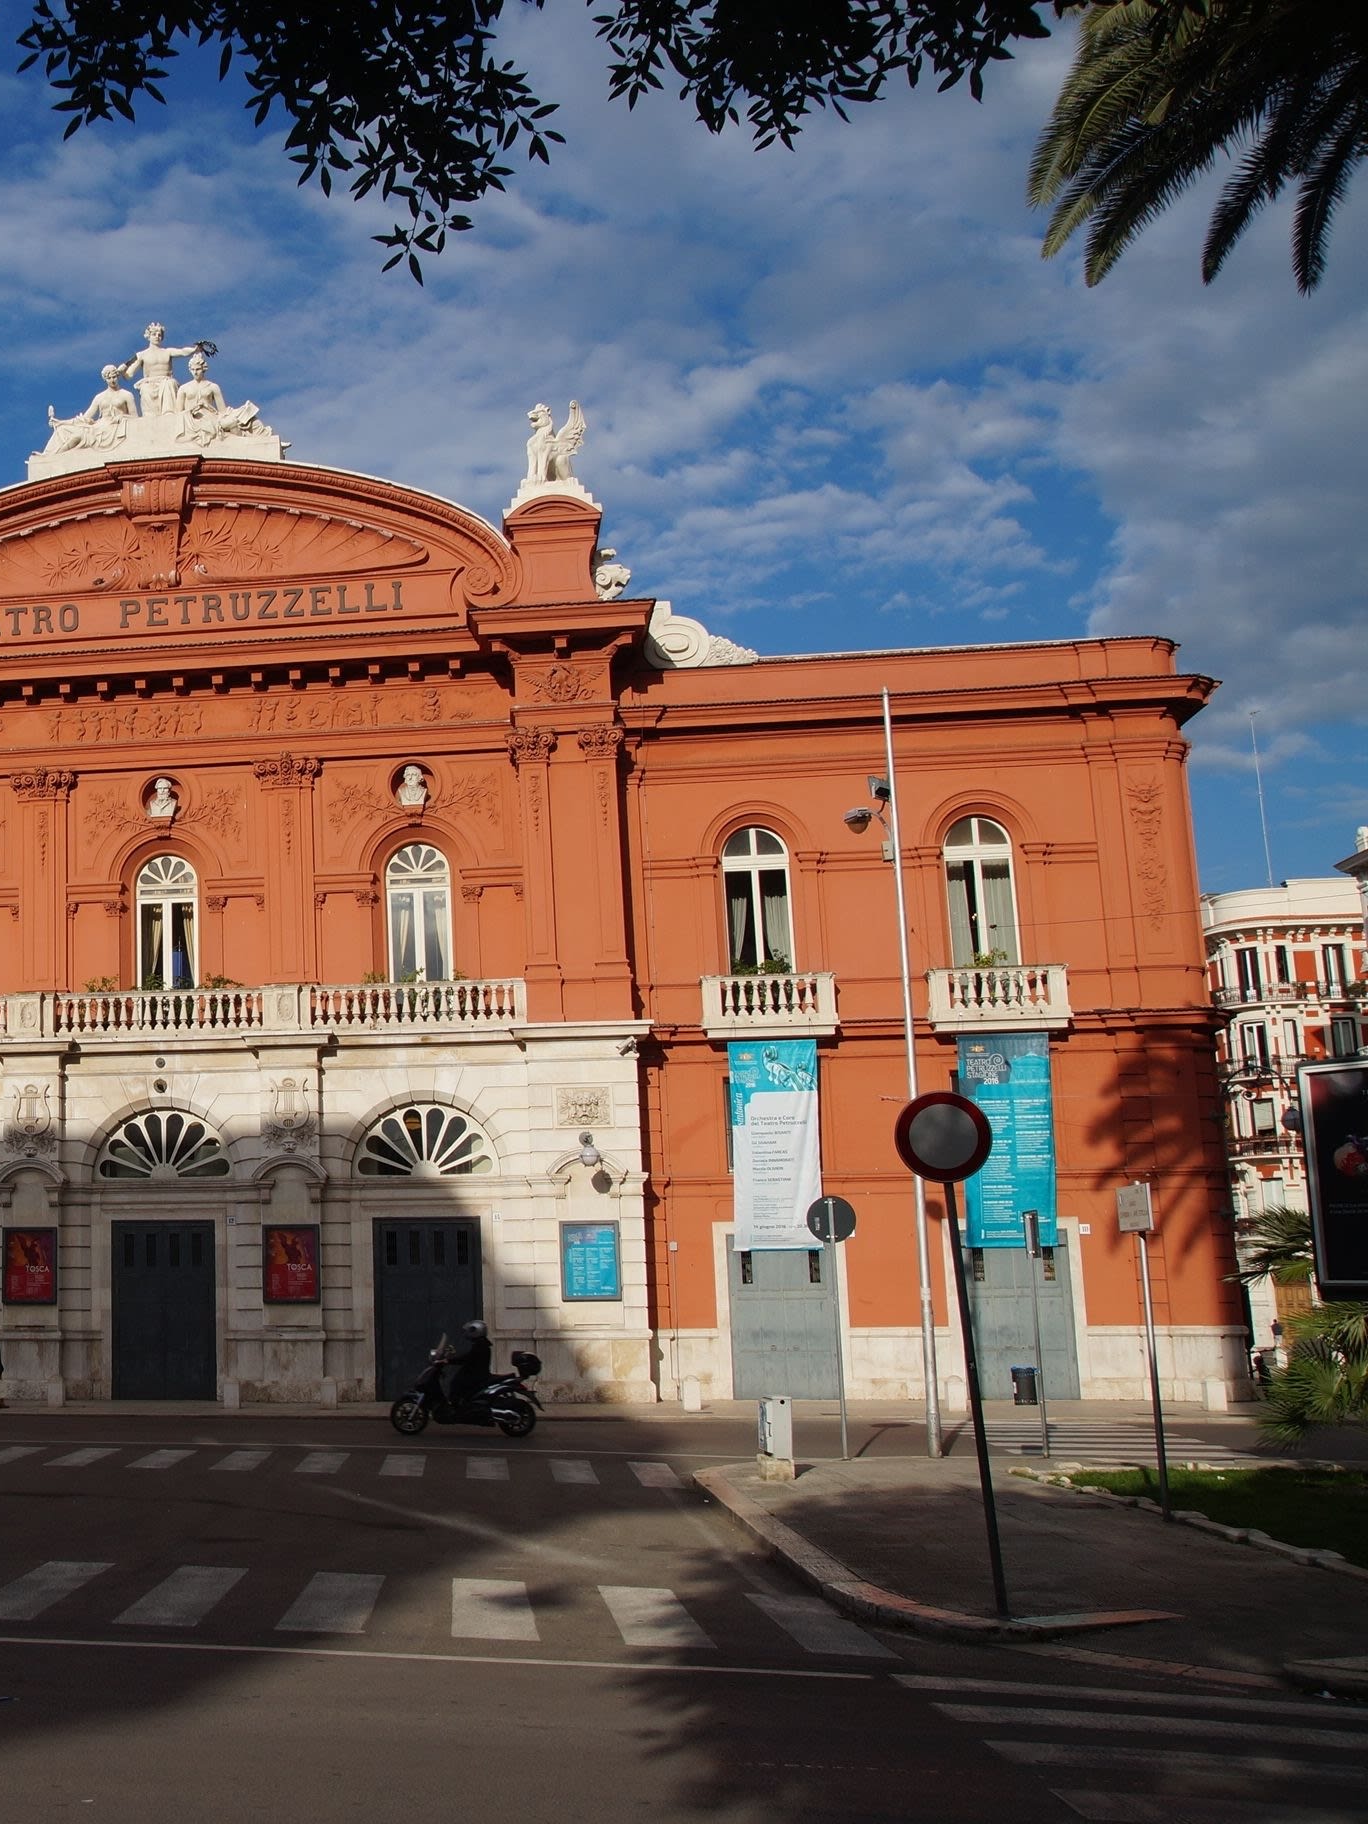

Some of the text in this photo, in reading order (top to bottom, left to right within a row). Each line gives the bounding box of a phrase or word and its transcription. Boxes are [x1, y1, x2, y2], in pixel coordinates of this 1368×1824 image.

[120, 581, 402, 629] PETRUZZELLI
[966, 1064, 1007, 1073] PETRUZZELLI
[25, 1264, 50, 1273] TOSCA
[287, 1263, 313, 1272] TOSCA
